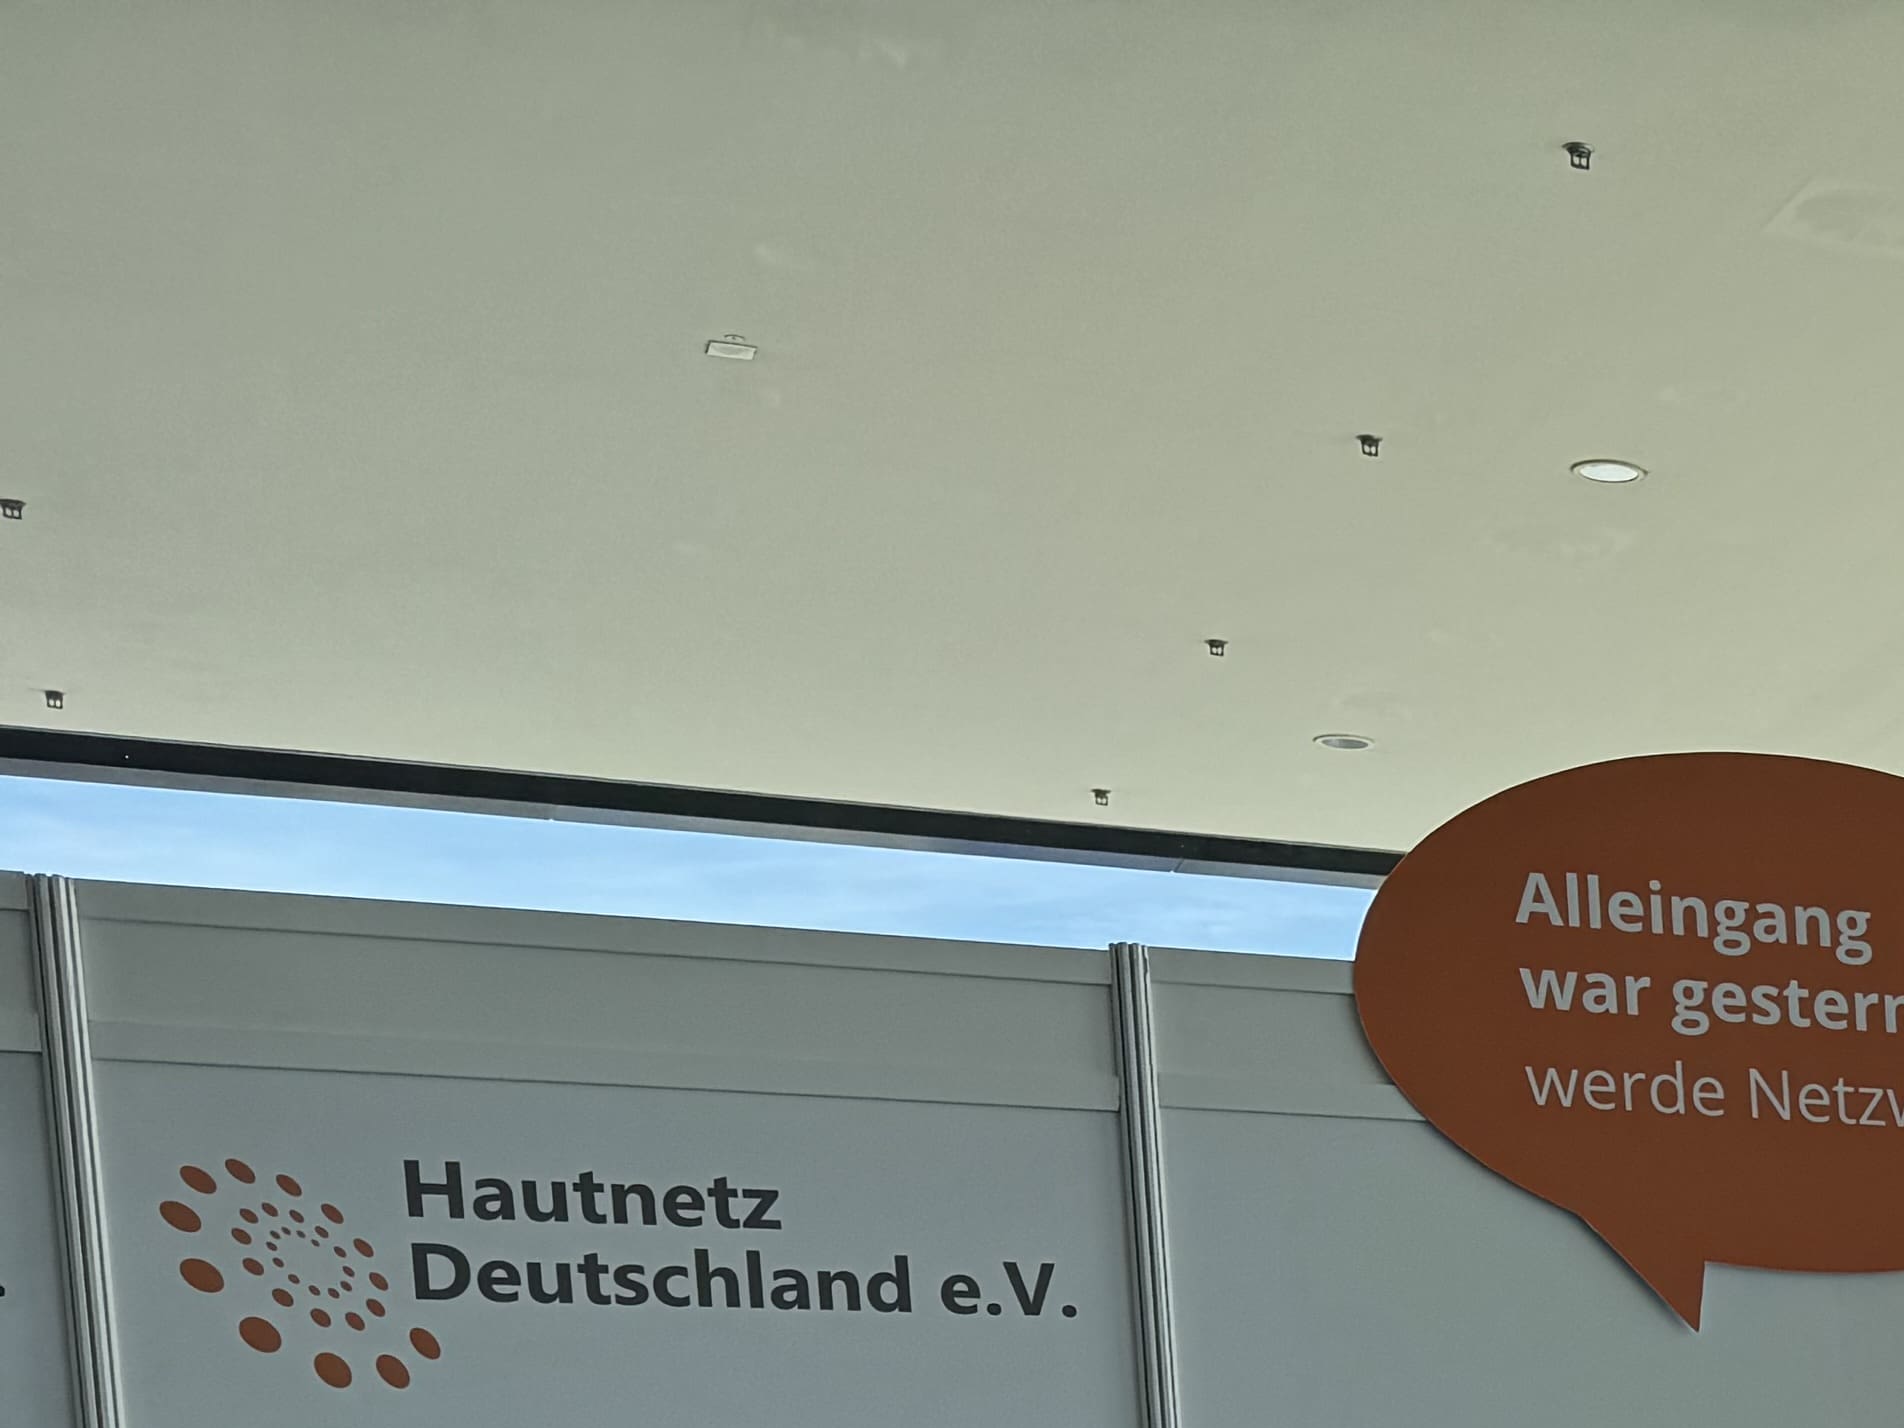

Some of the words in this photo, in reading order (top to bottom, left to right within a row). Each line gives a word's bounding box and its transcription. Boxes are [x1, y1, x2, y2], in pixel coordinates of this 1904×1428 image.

[1516, 872, 1873, 966] Alleingang
[1519, 968, 1649, 1016] war
[1526, 1059, 1726, 1117] werde
[403, 1159, 781, 1231] Hautnetz
[410, 1242, 913, 1315] Deutschland
[940, 1261, 1078, 1319] e.V.
